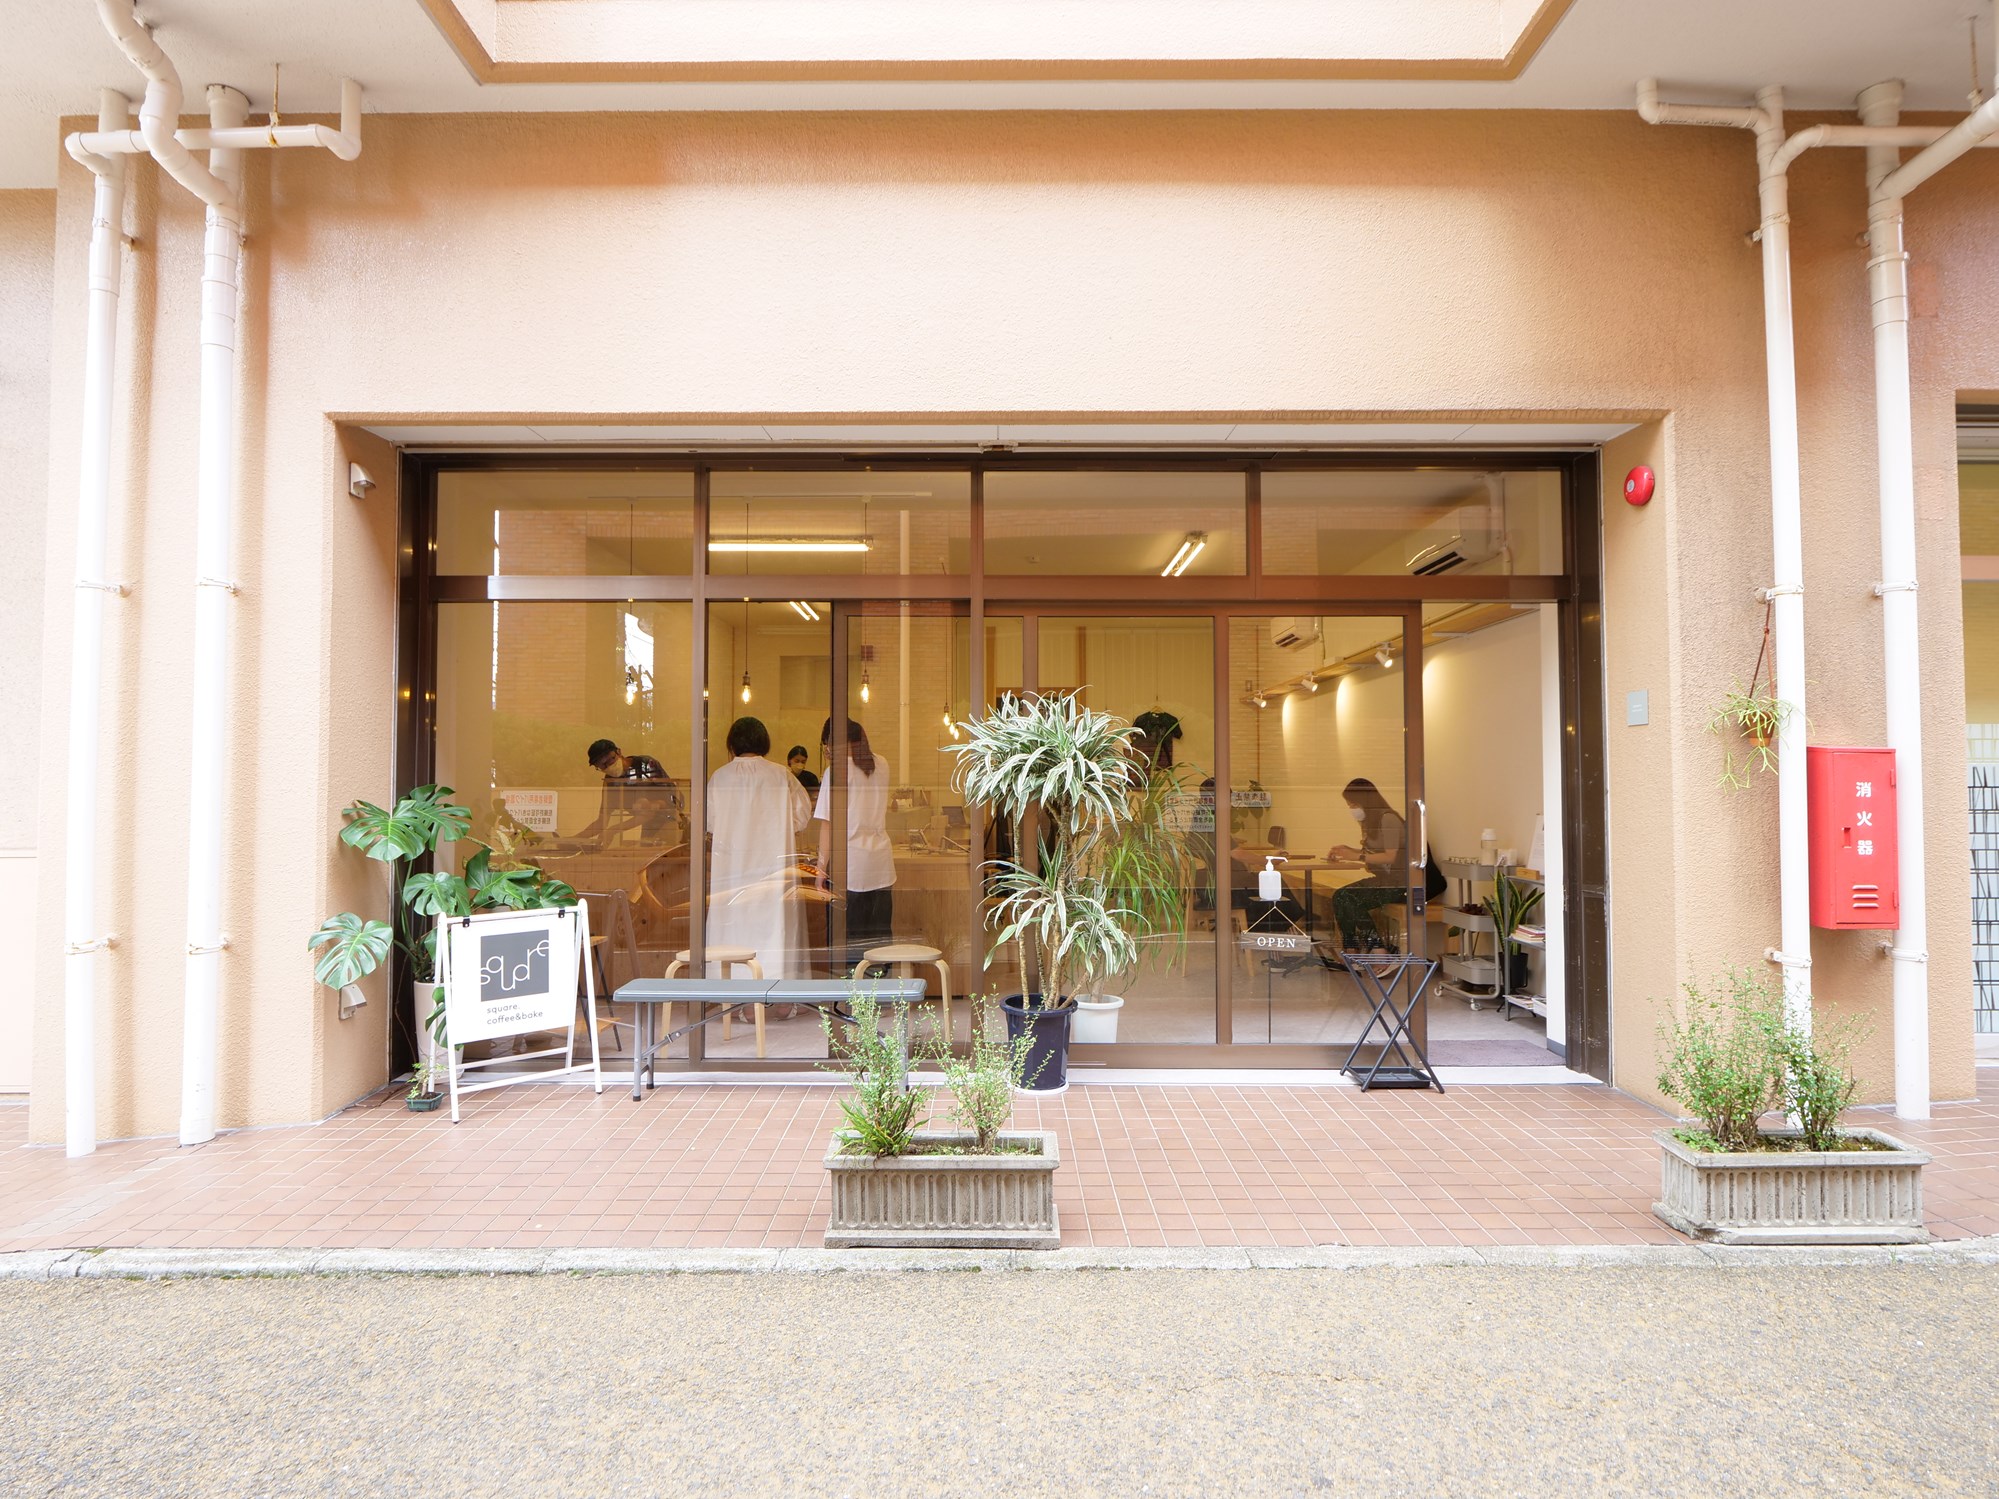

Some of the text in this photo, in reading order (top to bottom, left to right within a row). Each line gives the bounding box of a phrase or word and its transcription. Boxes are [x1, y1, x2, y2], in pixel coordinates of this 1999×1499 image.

[1856, 781, 1873, 855] 消火器
[1257, 936, 1296, 949] OPEN
[487, 1010, 544, 1025] coffee&bake
